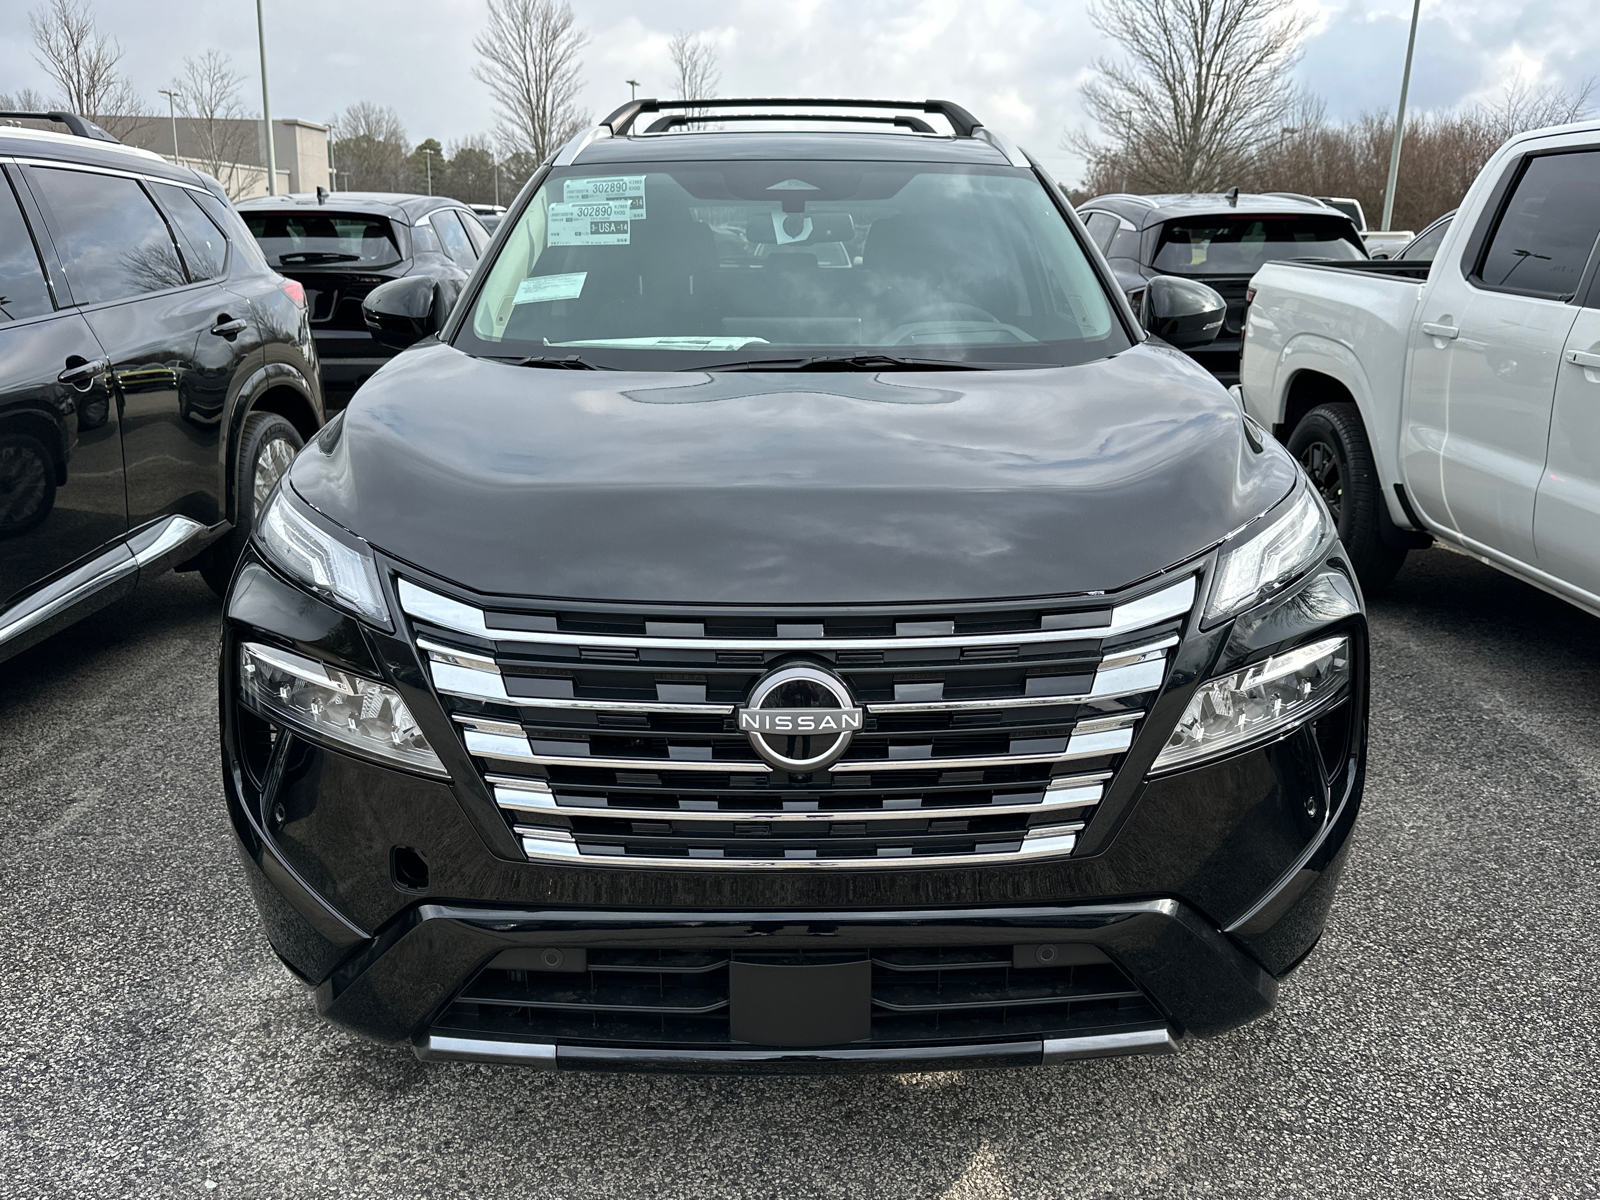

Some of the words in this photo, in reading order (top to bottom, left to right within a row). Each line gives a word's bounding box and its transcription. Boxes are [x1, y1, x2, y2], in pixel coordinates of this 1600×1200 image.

[592, 182, 628, 194] 302890
[577, 206, 613, 217] 302890
[598, 222, 616, 233] USA
[742, 713, 859, 730] NISSAN
